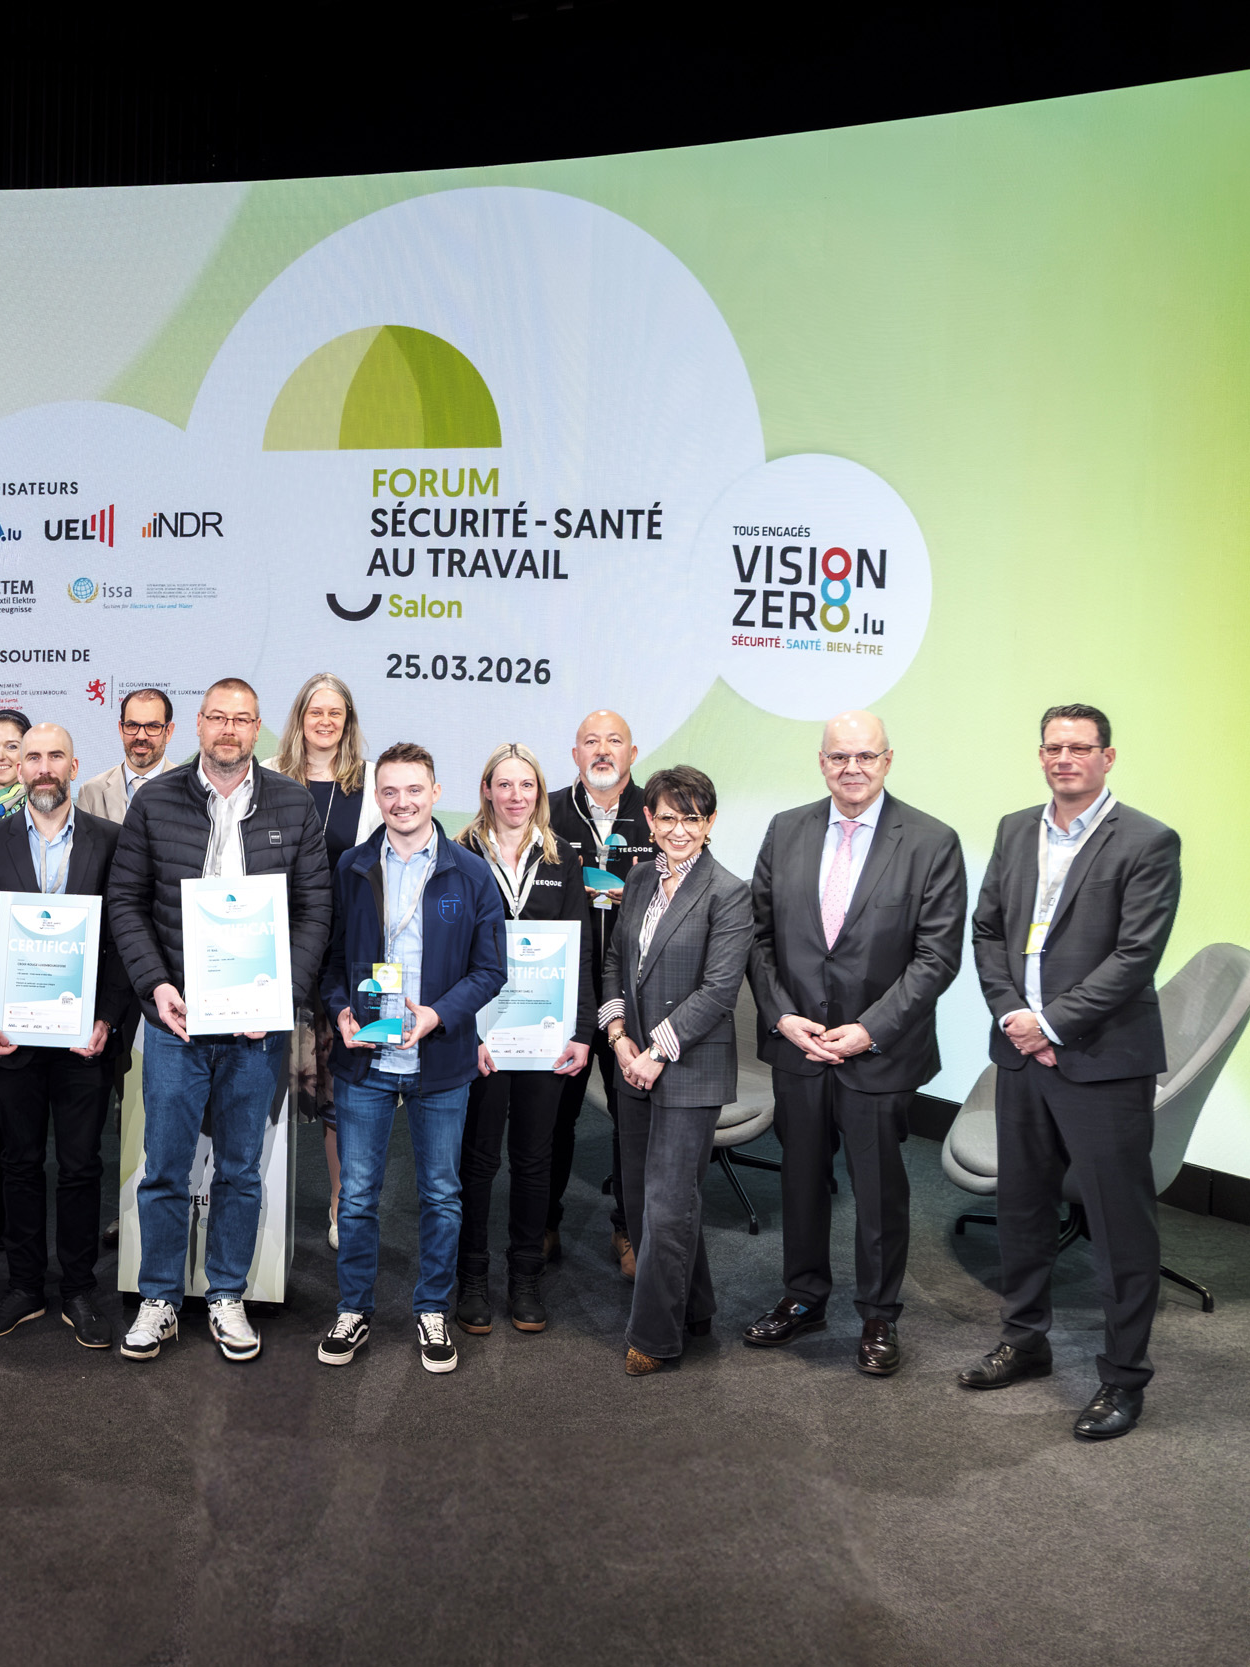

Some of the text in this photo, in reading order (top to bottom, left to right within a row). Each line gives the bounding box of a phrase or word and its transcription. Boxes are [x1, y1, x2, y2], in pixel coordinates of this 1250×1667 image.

[371, 467, 500, 498] FORUM
[152, 511, 225, 538] iNDR
[733, 524, 811, 538] TOUS ENGAGÉS
[366, 548, 569, 580] AU TRAVAIL
[732, 544, 888, 590] VISION
[102, 582, 133, 598] issa
[12, 596, 37, 605] Elektro
[387, 593, 463, 619] Salon
[0, 649, 67, 664] SOUTIEN
[71, 649, 91, 663] DE
[826, 641, 884, 656] BIEN-ÊTRE
[385, 653, 552, 685] 25.03.2026
[8, 937, 86, 955] CERTIFICAT
[507, 966, 567, 980] RTIFICAT
